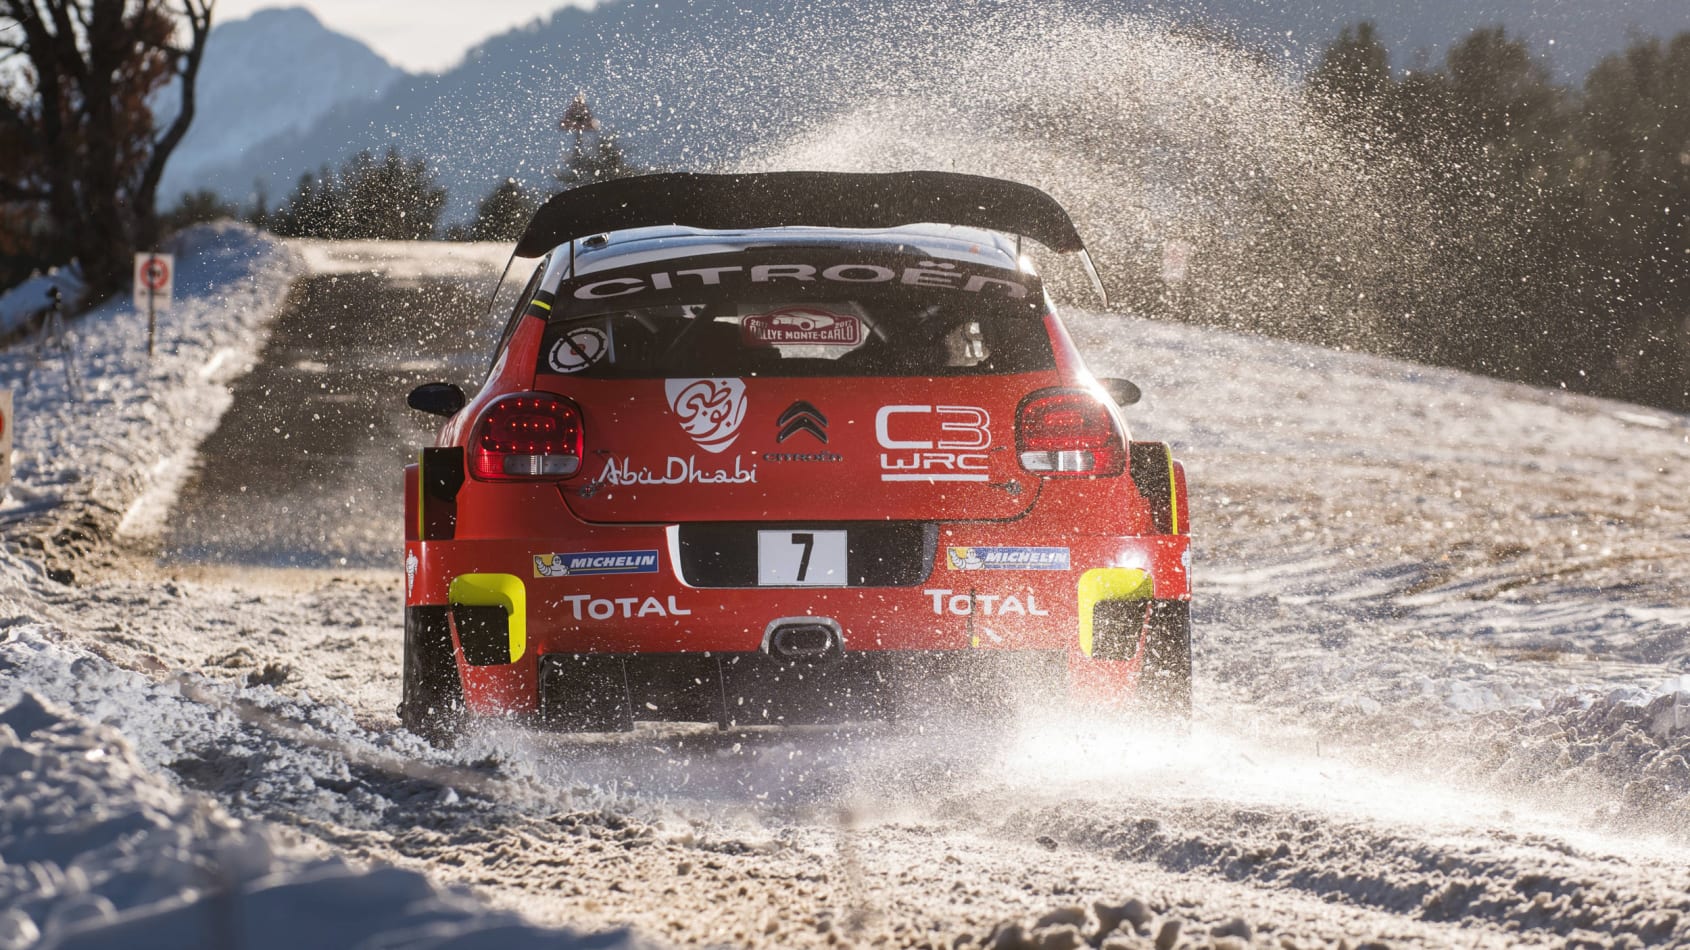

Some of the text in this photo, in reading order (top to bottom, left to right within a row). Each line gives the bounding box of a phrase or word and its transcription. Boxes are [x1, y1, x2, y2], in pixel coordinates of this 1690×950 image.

[749, 325, 853, 341] RALLYE MONTE-CARLO
[875, 405, 992, 450] C3
[880, 453, 989, 469] WRC
[570, 555, 655, 569] MICHELIN
[791, 533, 814, 582] 7
[985, 552, 1067, 563] MICHELIN
[563, 594, 691, 620] TOTAL
[924, 589, 1049, 615] TOTAL
